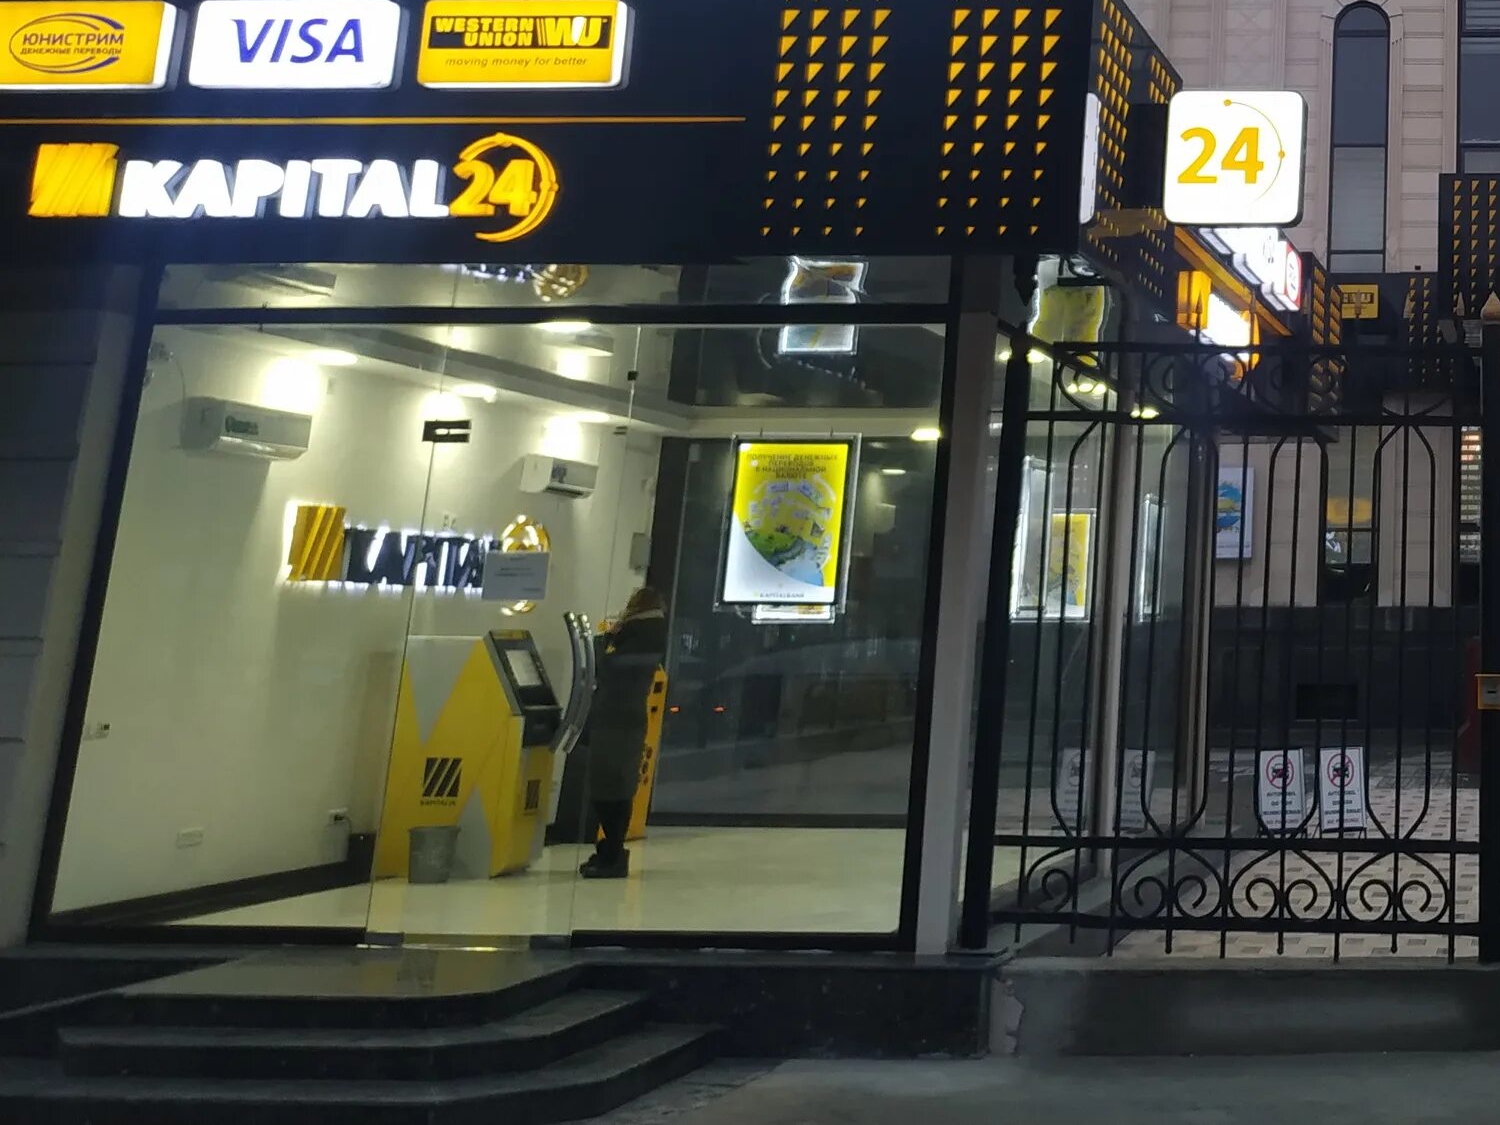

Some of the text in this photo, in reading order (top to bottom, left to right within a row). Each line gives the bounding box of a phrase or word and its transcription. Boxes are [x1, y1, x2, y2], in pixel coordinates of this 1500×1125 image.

[435, 17, 534, 33] WESTERN
[22, 32, 125, 46] ЮНИСТРИМ
[230, 18, 365, 63] VISA
[463, 32, 534, 47] UNION
[445, 56, 588, 68] moving money for better
[1177, 127, 1265, 185] 24
